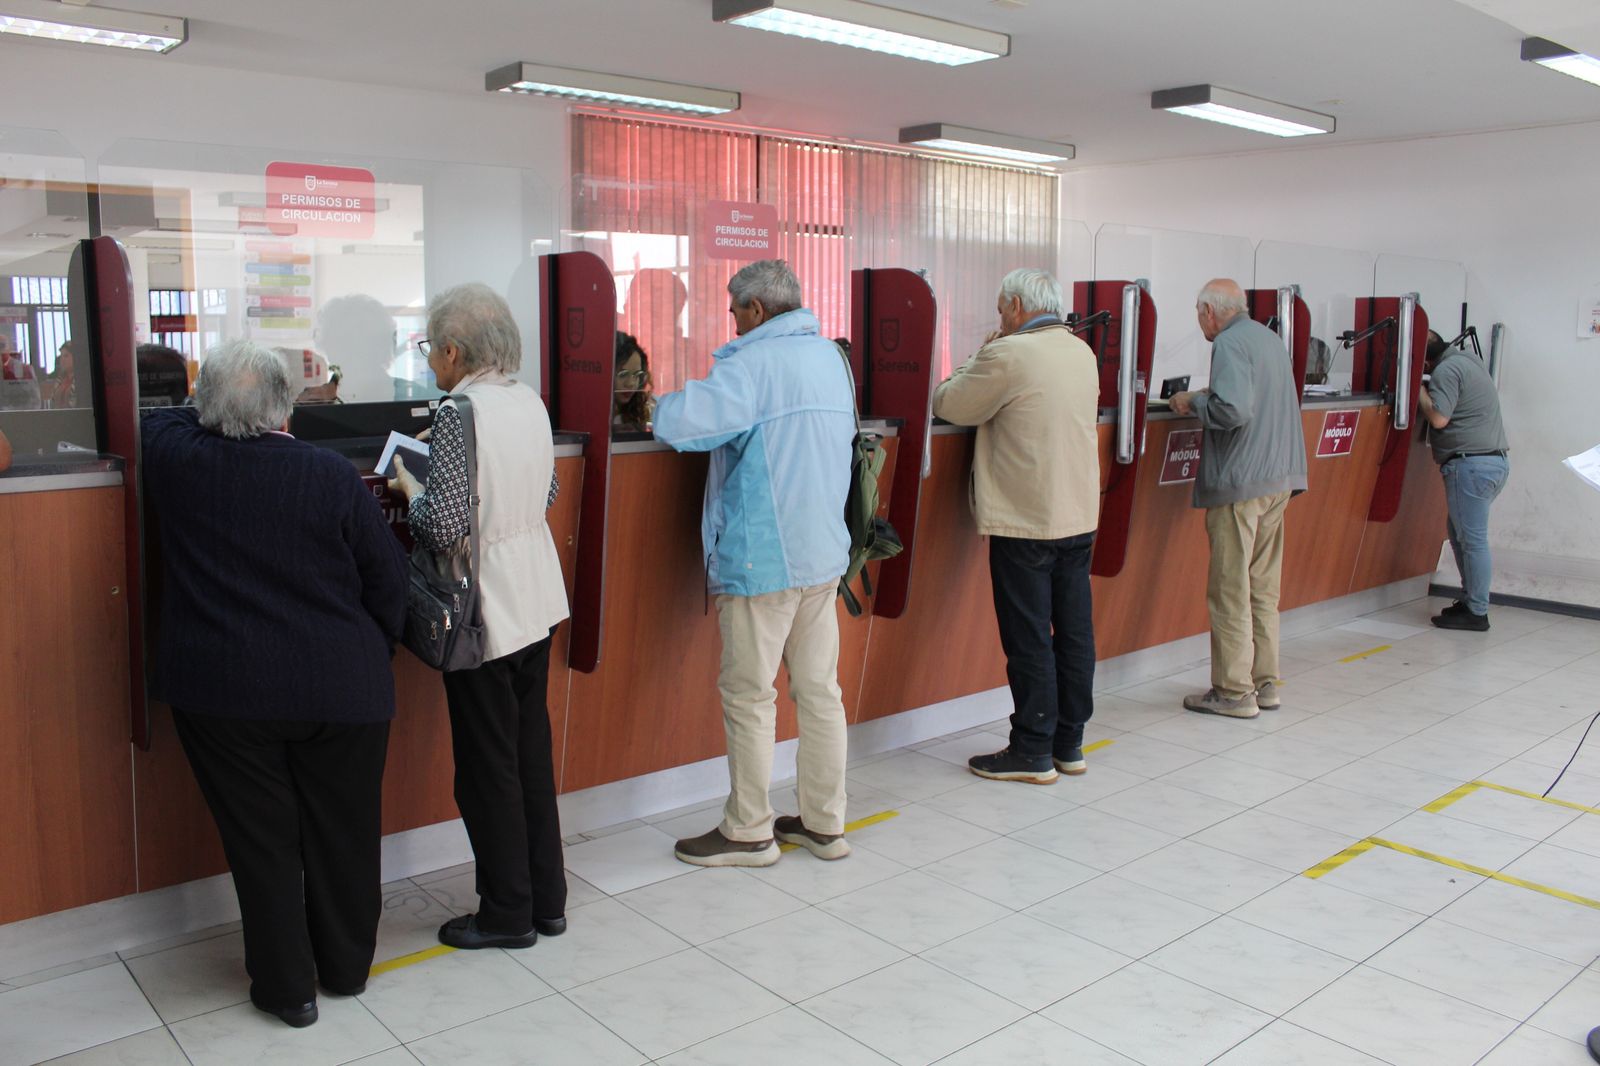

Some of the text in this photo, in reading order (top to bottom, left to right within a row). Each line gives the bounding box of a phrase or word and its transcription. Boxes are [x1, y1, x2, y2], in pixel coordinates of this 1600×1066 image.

[282, 194, 361, 209] PERMISOS DE
[282, 209, 361, 223] CIRCULACION
[715, 225, 769, 237] PERMISOS DE
[715, 237, 769, 249] CIRCULACION
[563, 355, 602, 374] Serena
[878, 358, 920, 373] Serena
[1325, 427, 1352, 438] MÓDULO
[1333, 439, 1340, 452] 7
[1170, 448, 1200, 462] MÓDUL
[1182, 462, 1190, 477] 6
